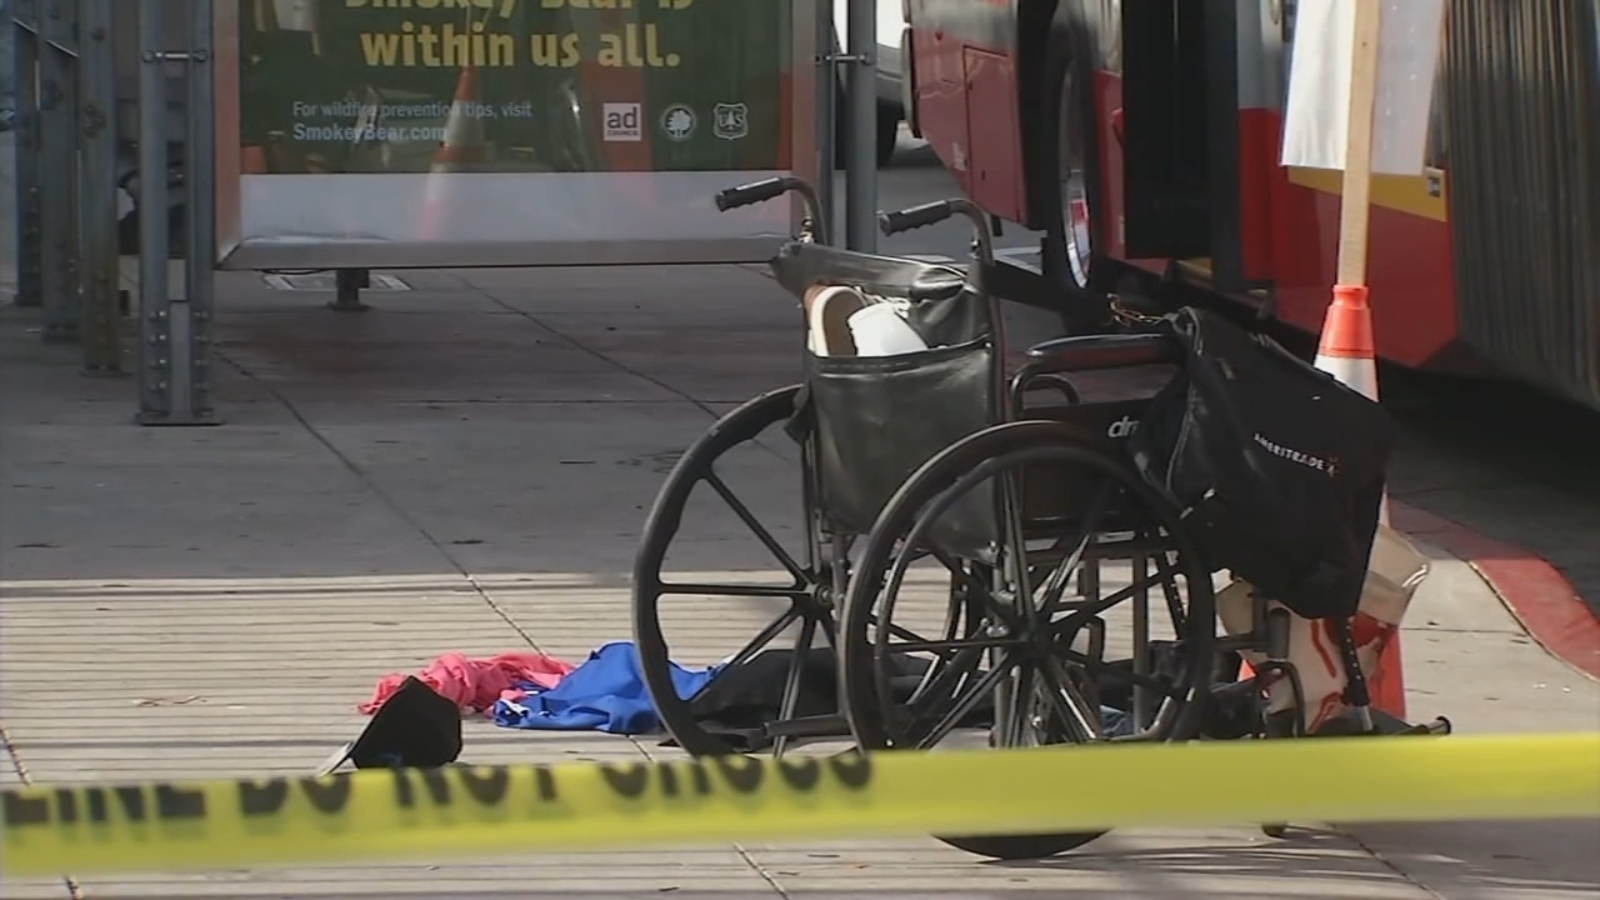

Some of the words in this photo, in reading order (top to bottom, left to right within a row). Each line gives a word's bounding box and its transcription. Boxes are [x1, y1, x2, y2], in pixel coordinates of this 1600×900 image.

[360, 21, 514, 67] within
[531, 34, 580, 67] us
[597, 23, 681, 67] all.
[293, 101, 317, 116] For
[320, 101, 377, 117] wildfire
[380, 101, 460, 120] prevention
[465, 101, 498, 120] tips,
[501, 101, 533, 117] visit
[607, 106, 637, 129] ad
[293, 123, 449, 143] SmokeyBear.com
